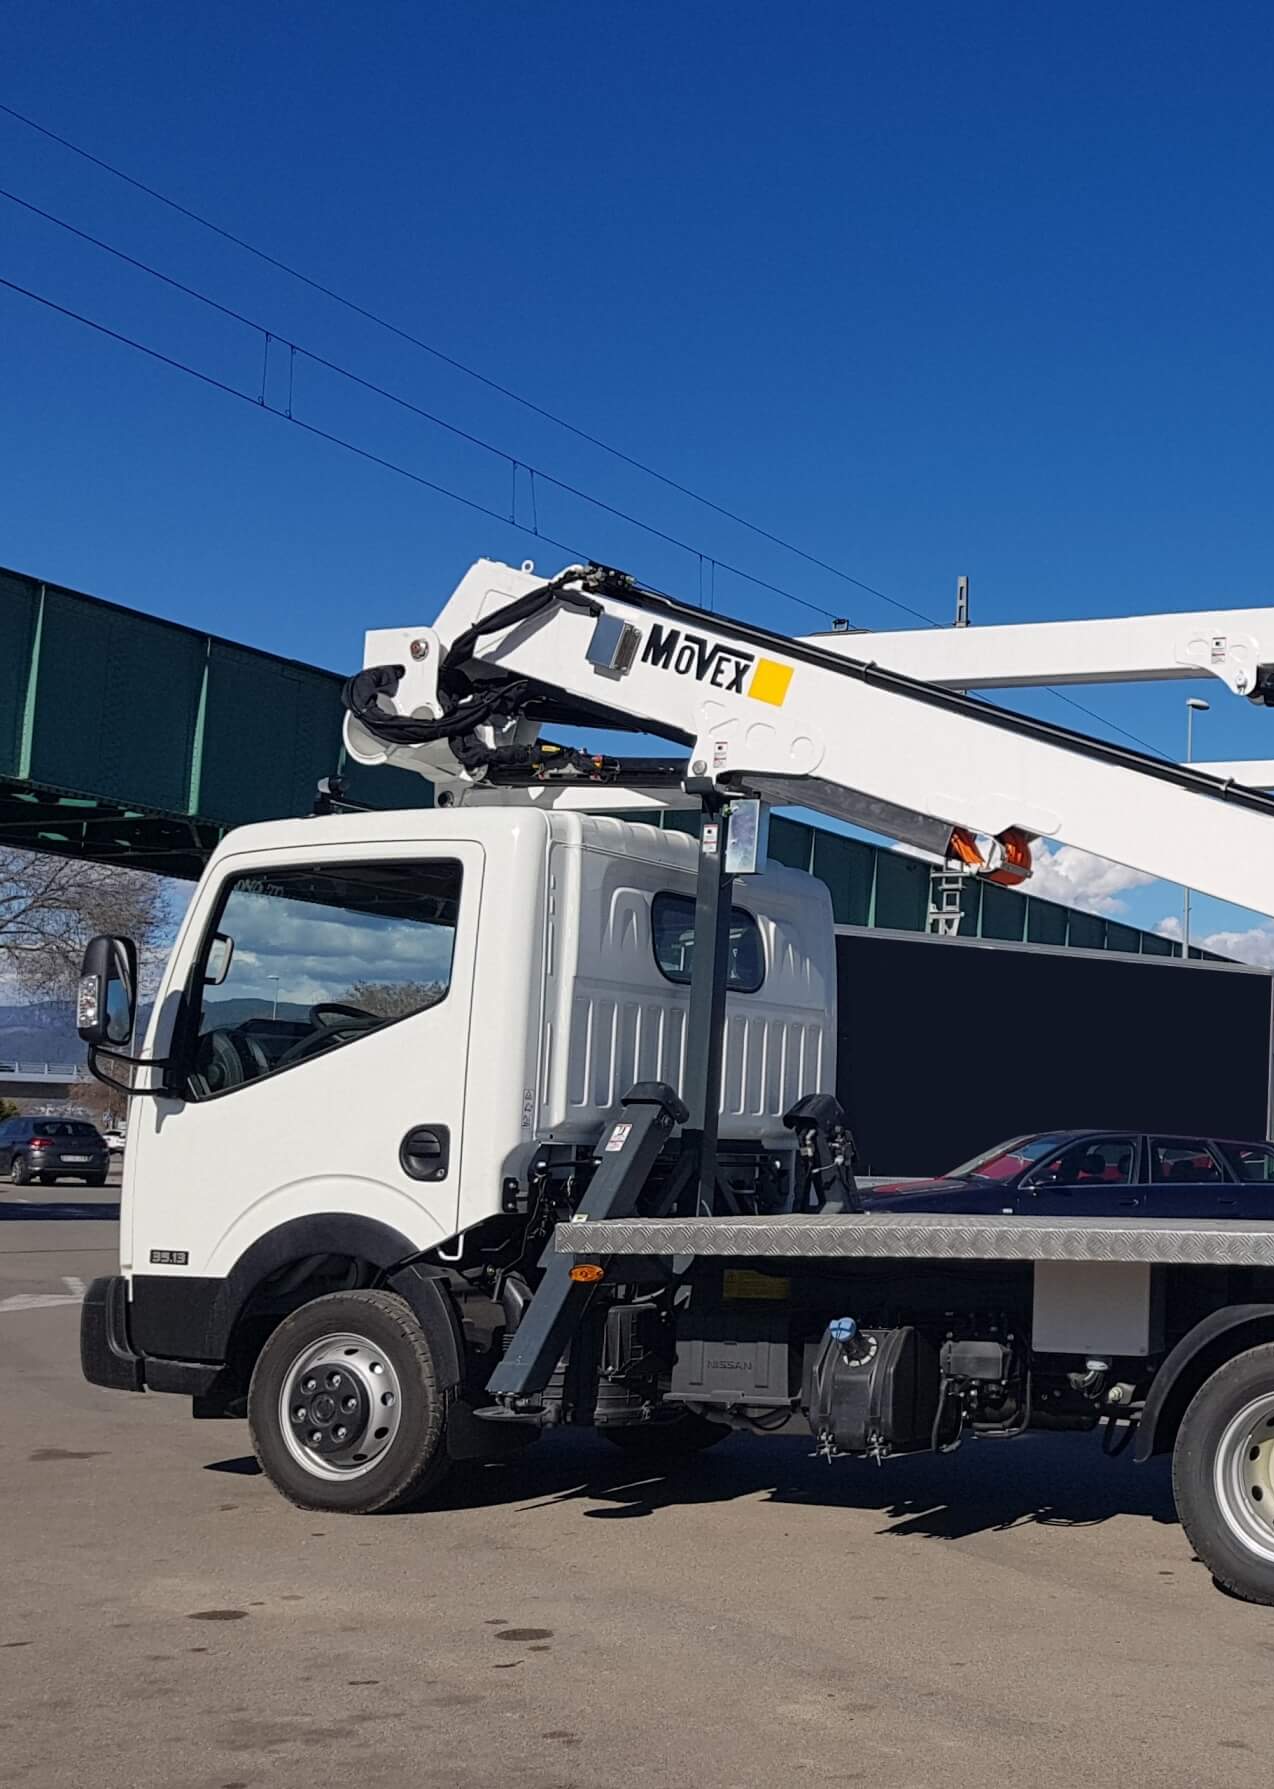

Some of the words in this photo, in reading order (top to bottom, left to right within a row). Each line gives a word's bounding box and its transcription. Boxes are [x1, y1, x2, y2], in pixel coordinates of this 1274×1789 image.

[641, 623, 755, 694] MOVEX
[150, 1250, 188, 1265] 35.13
[707, 1360, 752, 1370] NISSAN
